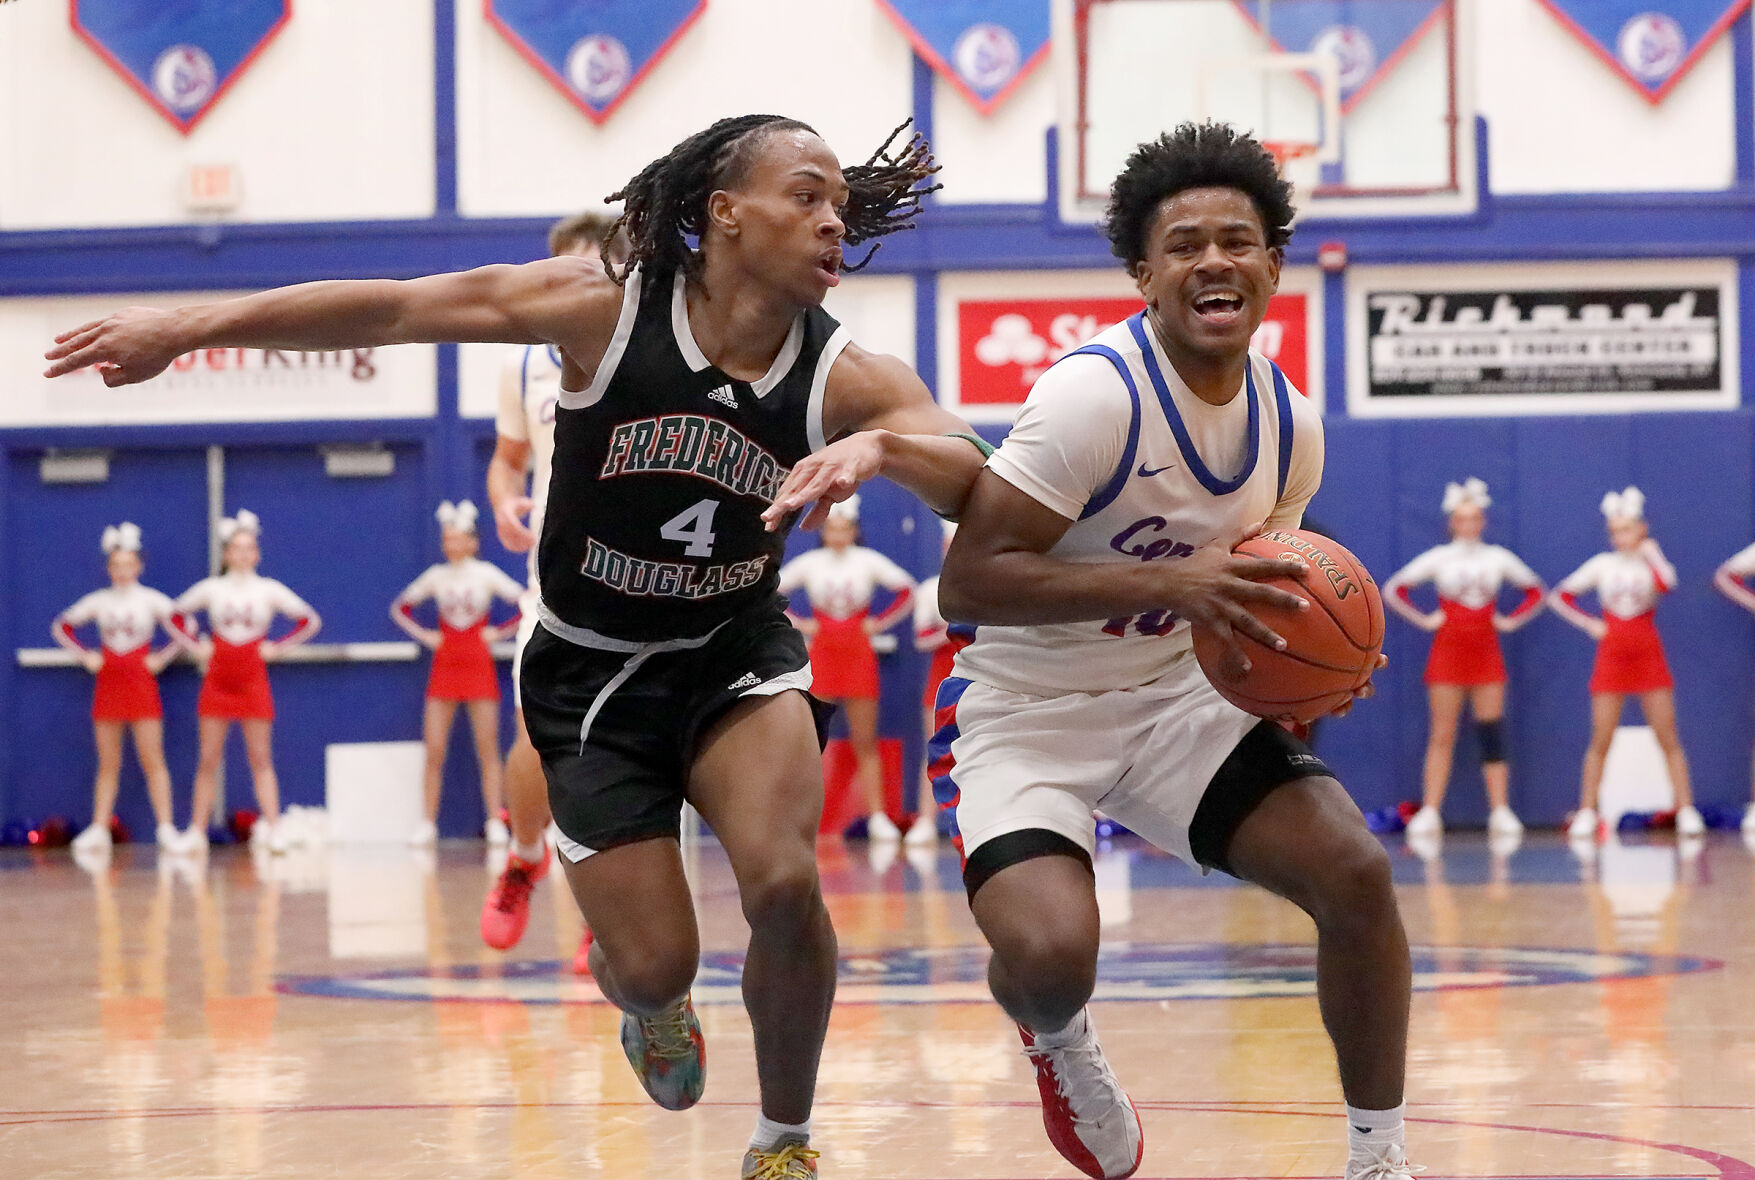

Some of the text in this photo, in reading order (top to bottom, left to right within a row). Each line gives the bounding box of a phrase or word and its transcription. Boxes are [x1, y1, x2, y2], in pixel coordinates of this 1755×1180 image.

[1370, 290, 1716, 337] Richmond
[707, 392, 739, 409] adidas
[659, 498, 720, 558] 4
[580, 536, 770, 600] DOUGLASS
[1257, 531, 1360, 601] SPALDIN
[727, 677, 762, 690] adidas
